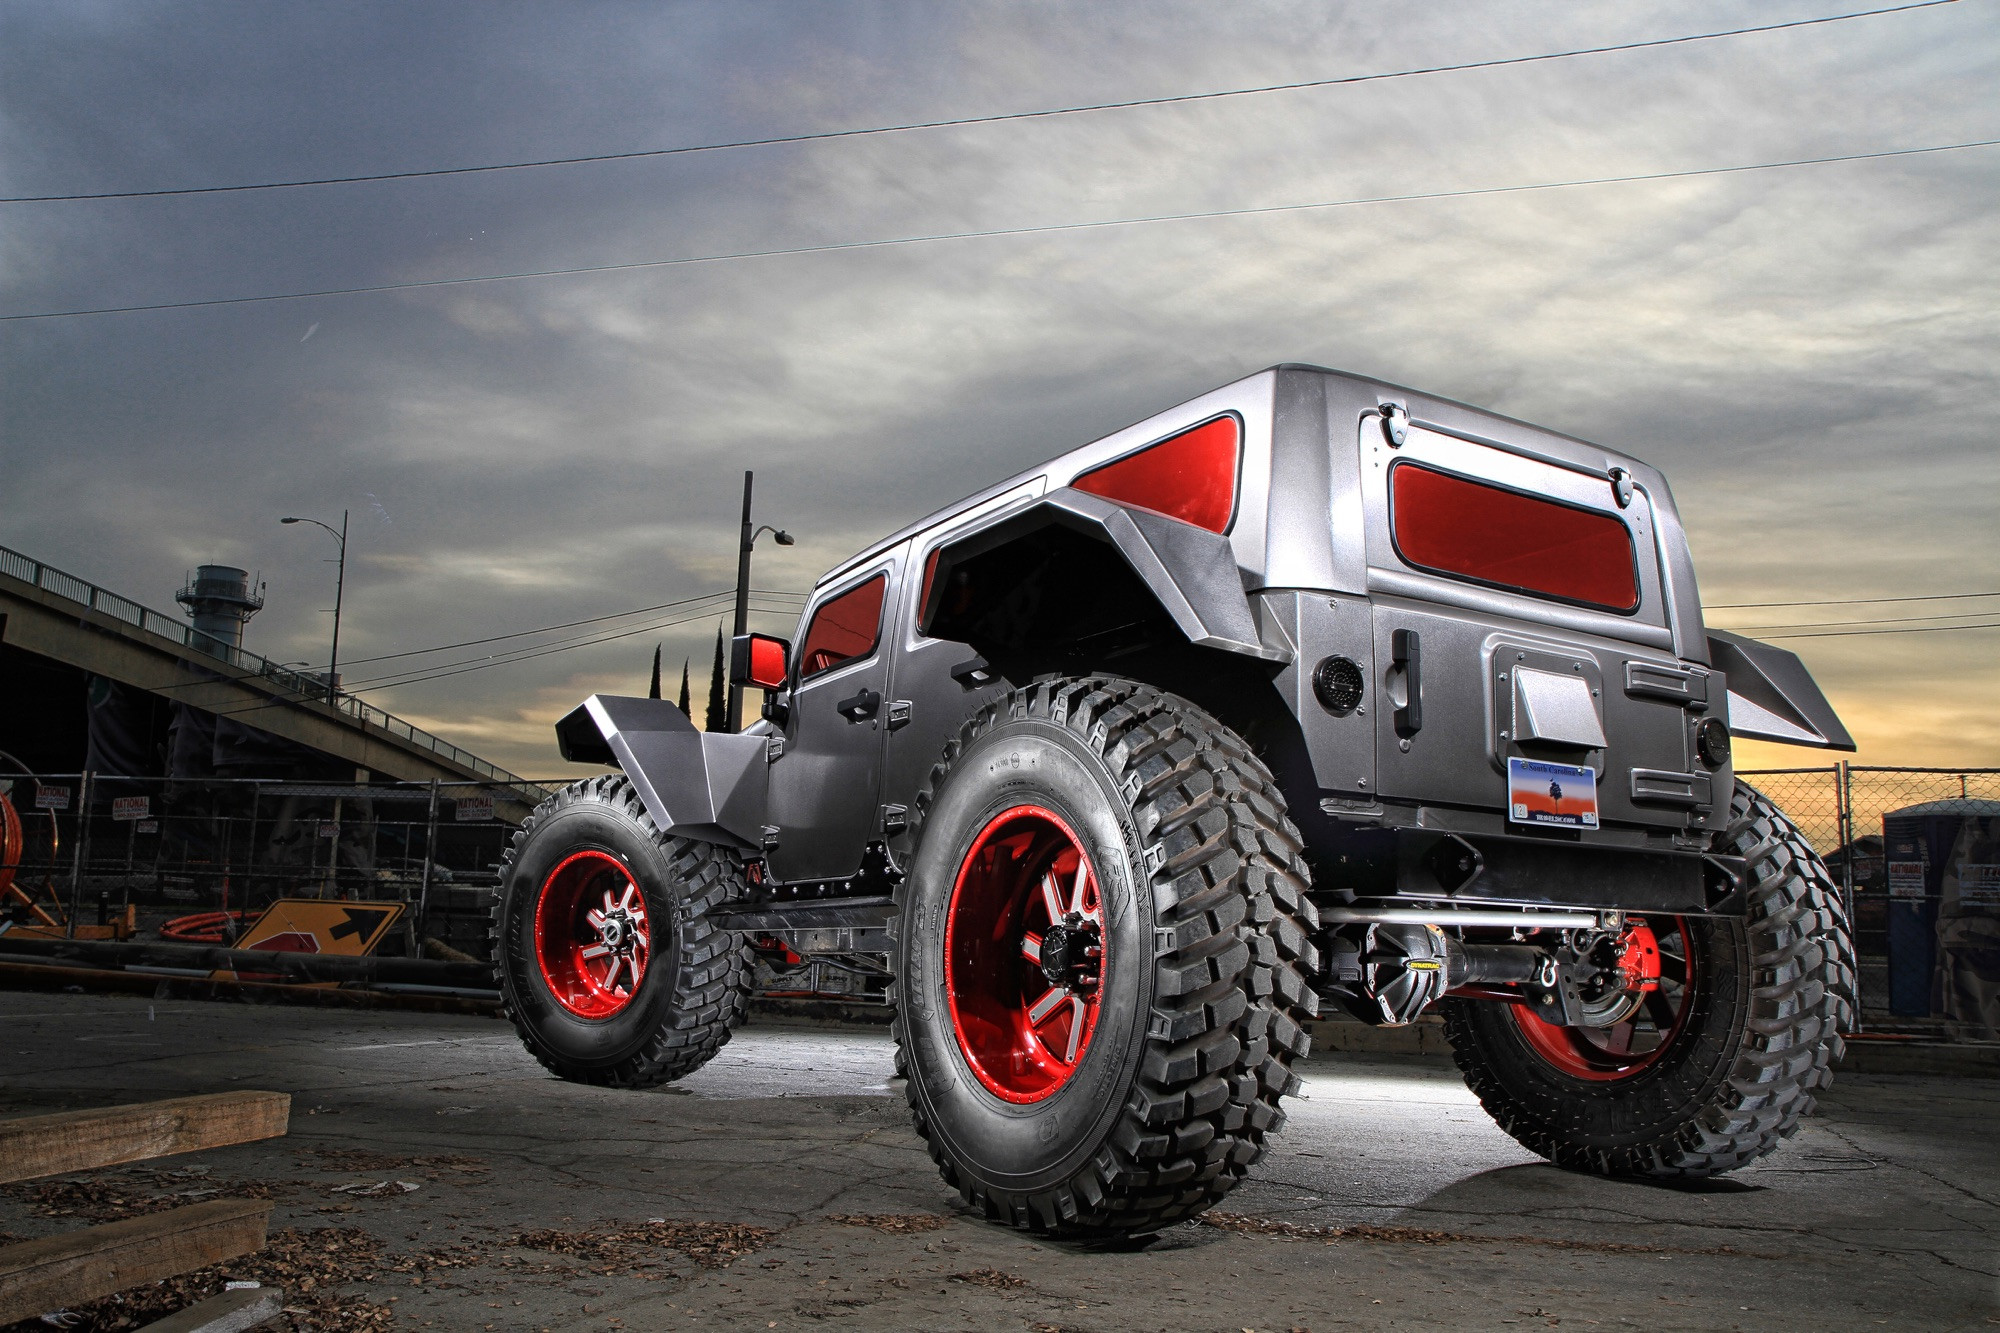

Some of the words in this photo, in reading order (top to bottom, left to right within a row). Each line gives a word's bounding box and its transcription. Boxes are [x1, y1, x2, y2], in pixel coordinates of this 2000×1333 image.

[1528, 763, 1547, 773] South
[1548, 765, 1576, 777] Carolina
[39, 786, 68, 797] NATIONAL
[115, 797, 147, 808] NATIONAL
[458, 798, 493, 808] NATIONAL
[1890, 863, 1921, 874] NATIONAL
